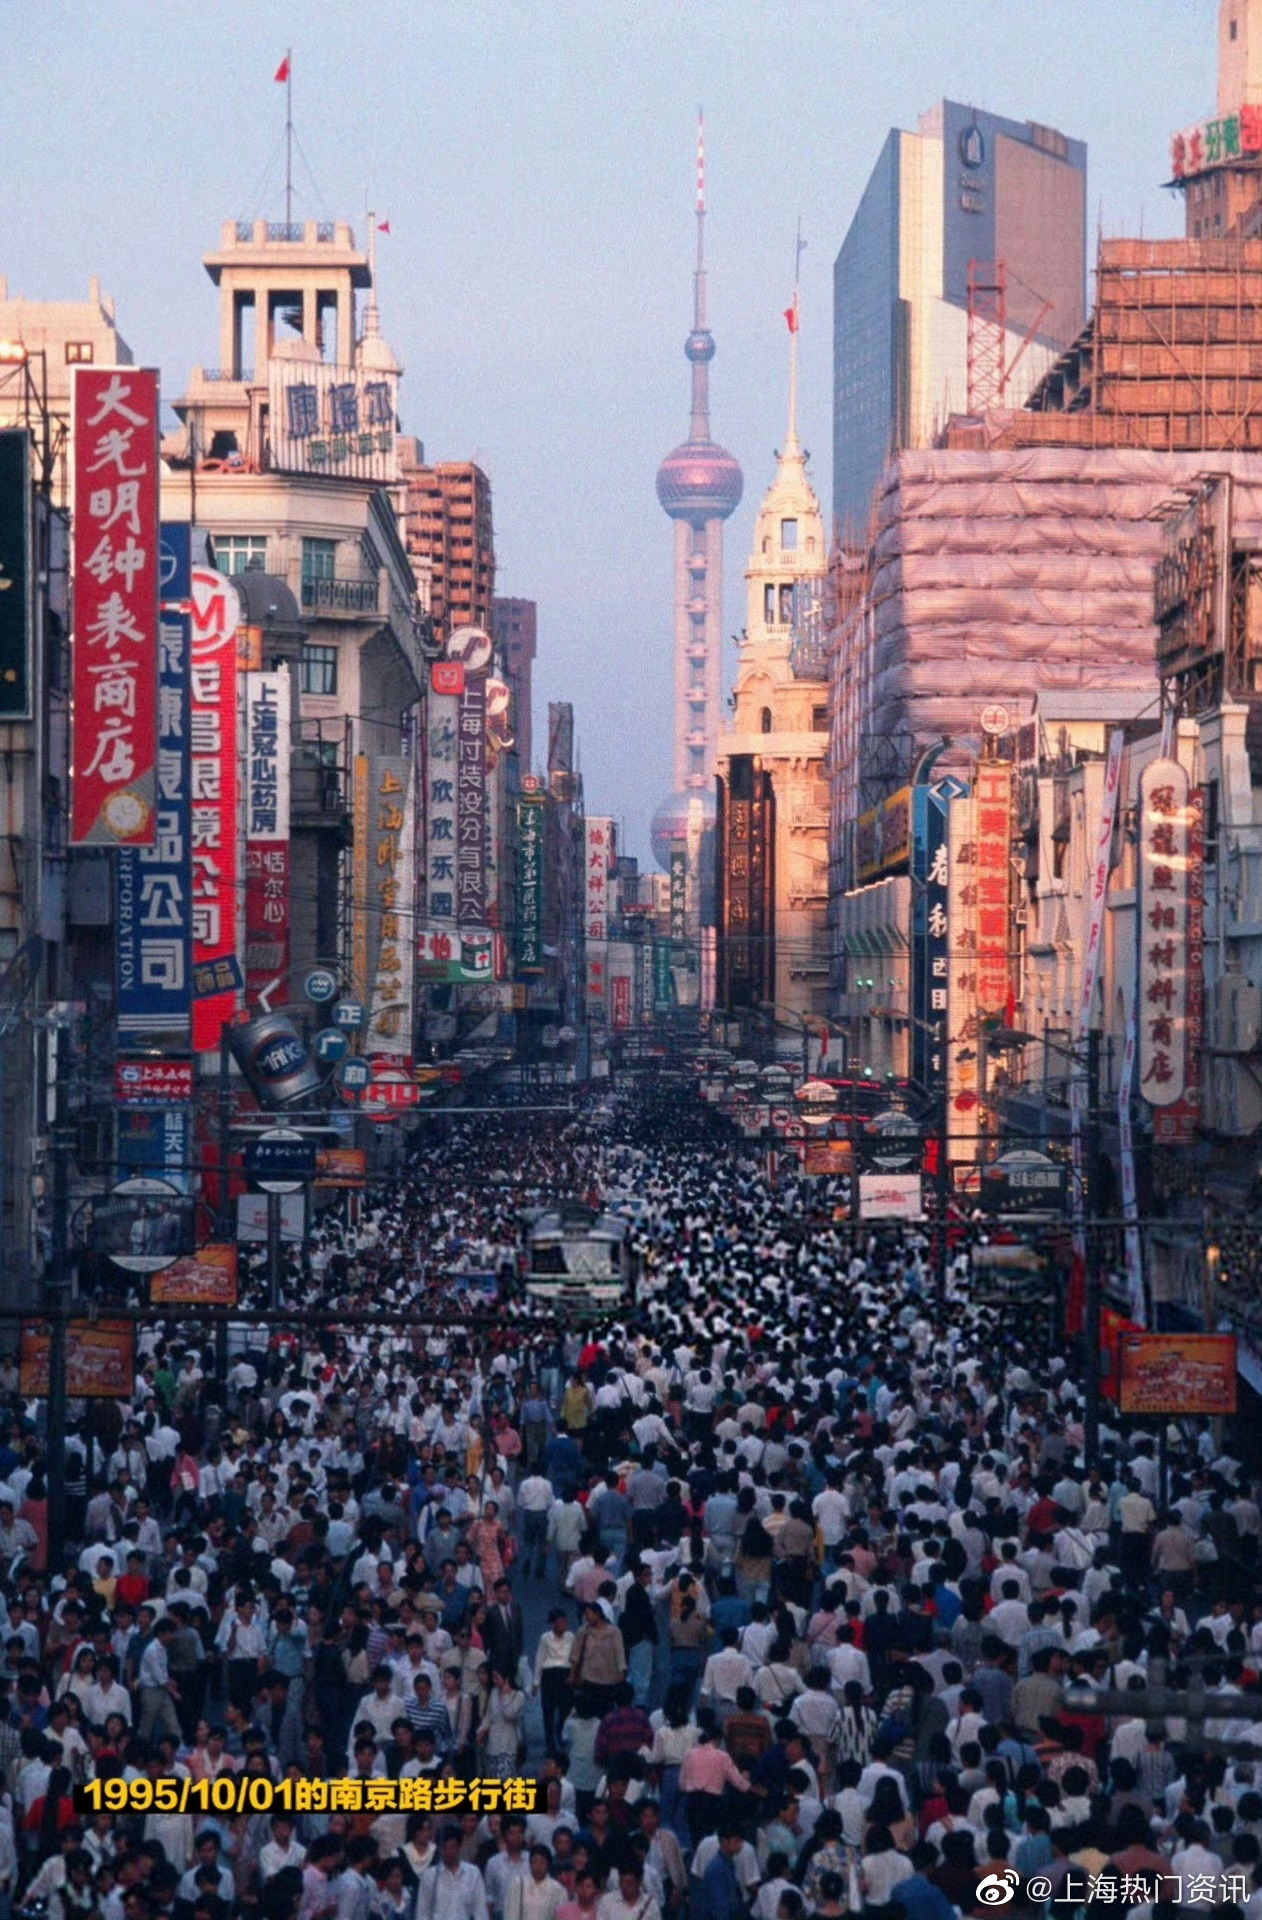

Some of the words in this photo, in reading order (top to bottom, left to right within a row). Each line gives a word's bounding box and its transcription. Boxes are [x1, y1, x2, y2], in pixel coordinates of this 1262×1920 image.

[83, 375, 149, 784] 大光明钟表商店
[250, 682, 279, 835] 上海冠心药房
[263, 851, 286, 924] 恬尔心
